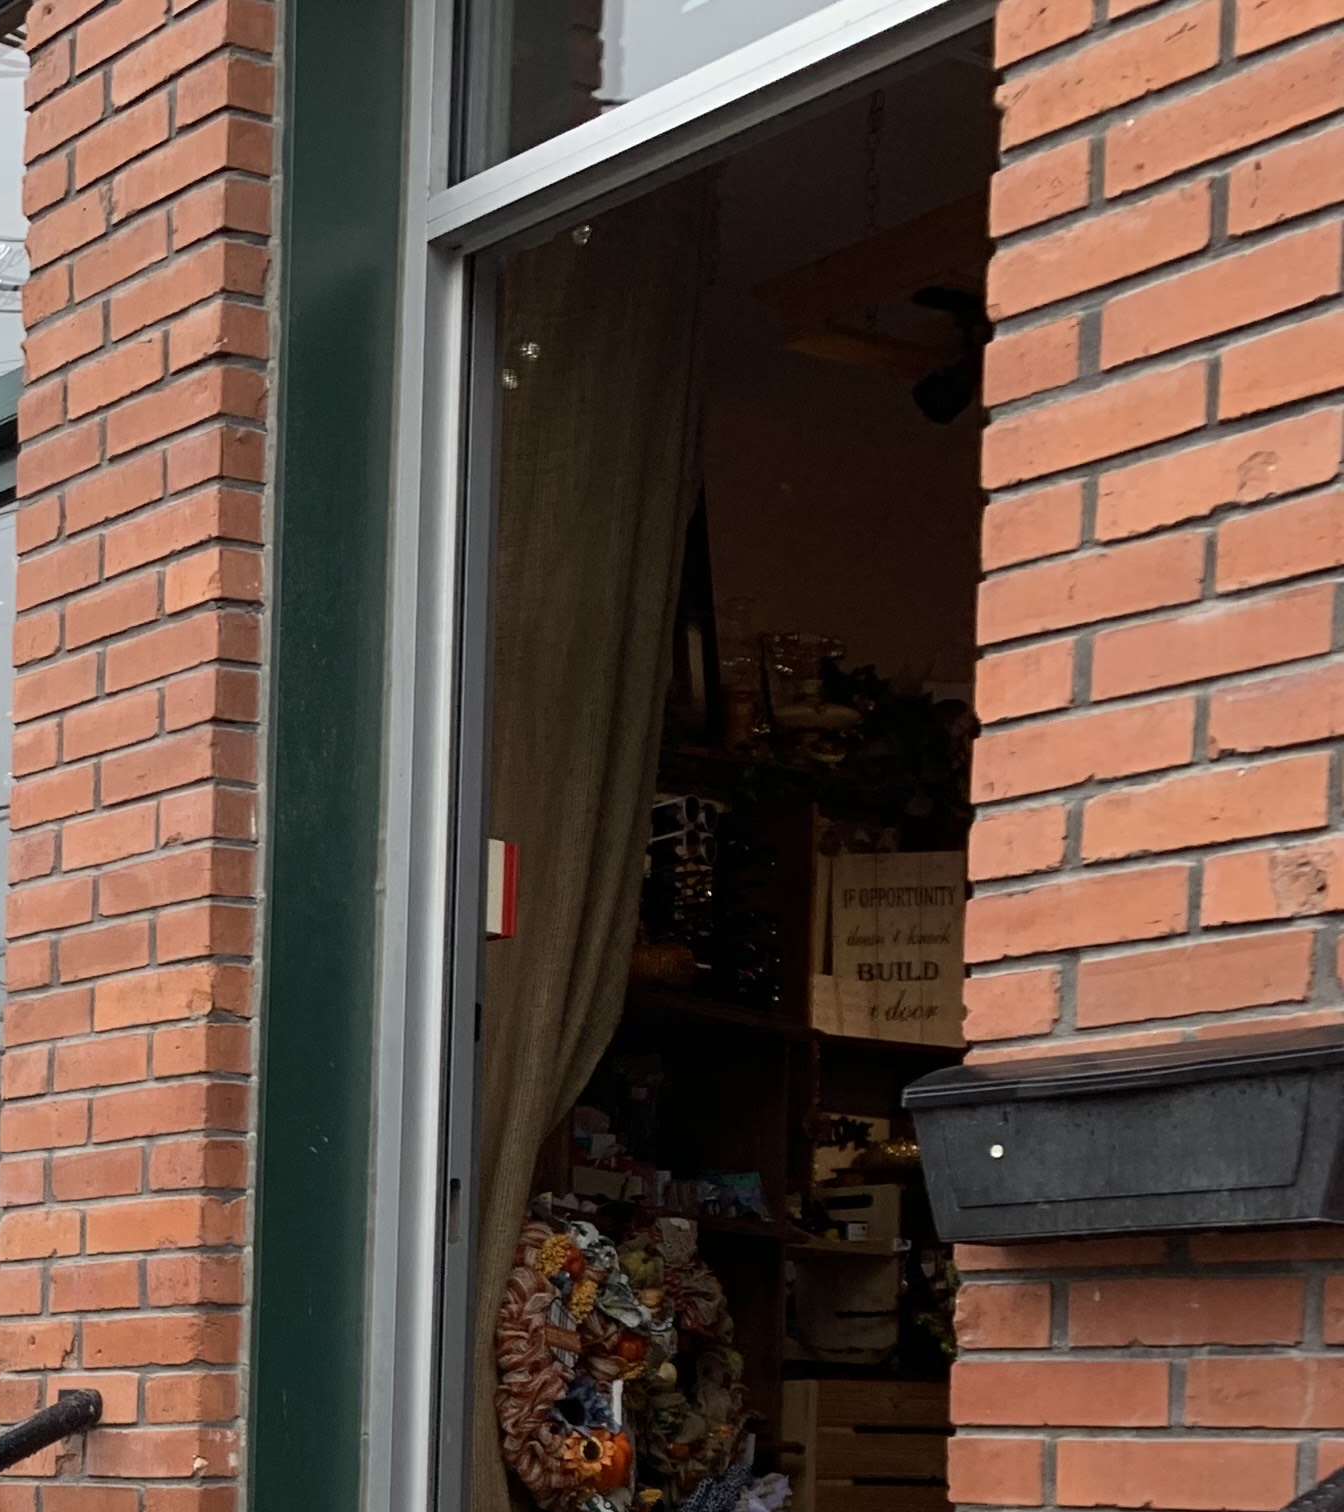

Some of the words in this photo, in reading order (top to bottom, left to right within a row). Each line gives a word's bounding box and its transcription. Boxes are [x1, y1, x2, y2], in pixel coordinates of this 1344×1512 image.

[843, 888, 857, 908] IF
[859, 885, 957, 908] OPPORTUNITY
[857, 961, 940, 982] BUILD
[884, 988, 940, 1022] door
